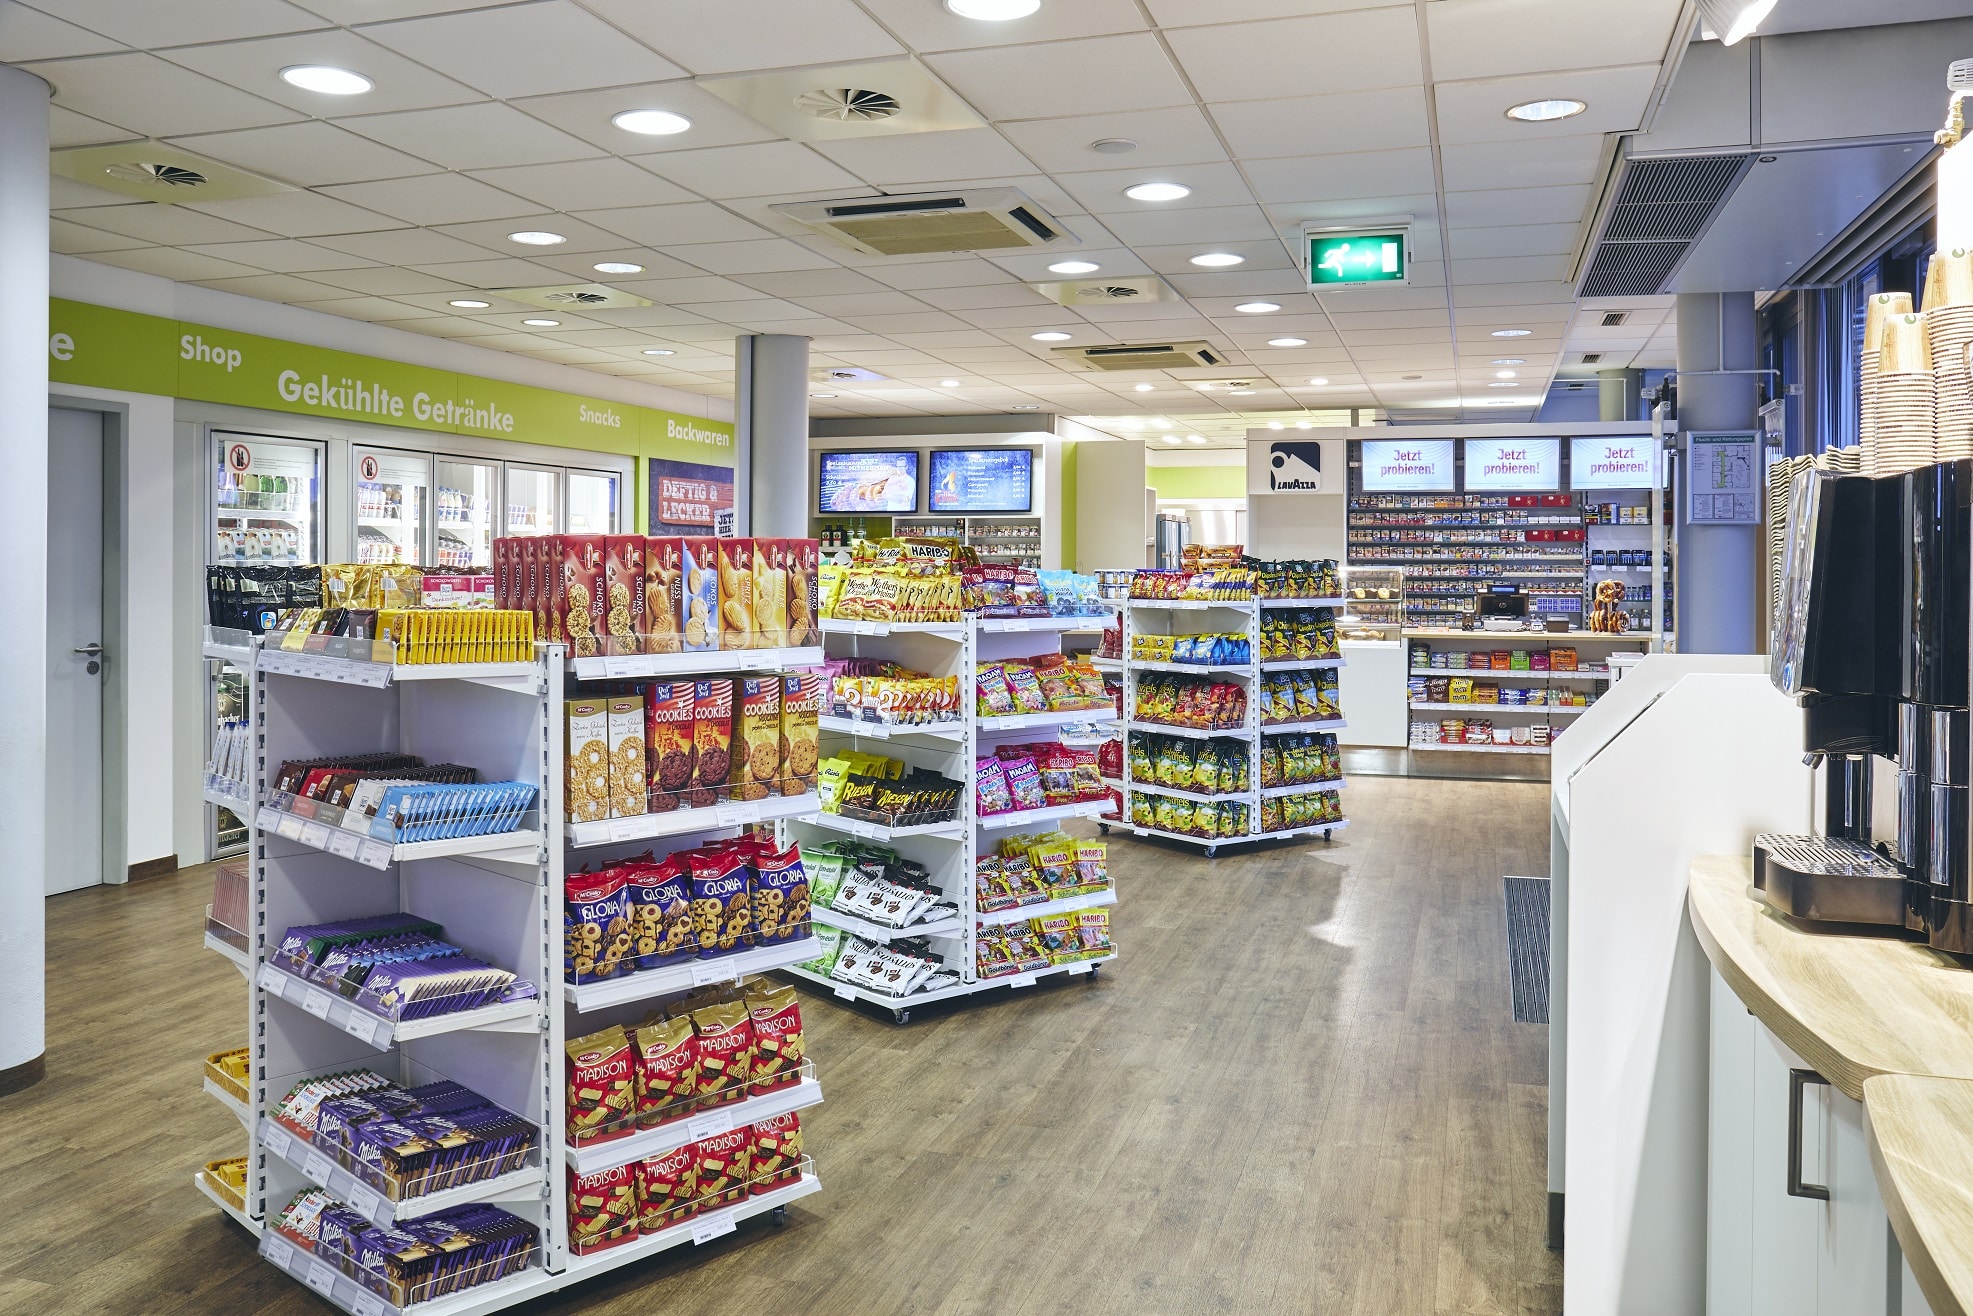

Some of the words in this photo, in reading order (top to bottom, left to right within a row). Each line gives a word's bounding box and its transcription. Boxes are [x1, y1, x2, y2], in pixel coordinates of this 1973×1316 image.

[180, 335, 242, 372] Shop
[278, 369, 404, 417] Gekühlte
[412, 392, 514, 432] Getränke
[579, 405, 621, 428] Snacks
[667, 419, 729, 447] Backwaren
[1393, 449, 1422, 461] Jetzt
[1497, 448, 1527, 460] Jetzt
[1605, 447, 1635, 459] Jetzt
[1380, 463, 1435, 477] probieren!
[1483, 462, 1540, 477] probieren!
[1590, 461, 1648, 475] probieren!
[662, 480, 707, 501] DEFTIG
[710, 484, 718, 501] &
[1277, 479, 1316, 490] LAVAZZA
[662, 501, 711, 522] LECKER
[911, 546, 950, 558] HARIBO
[656, 708, 693, 722] COOKIES
[695, 706, 732, 720] COOKIES
[744, 702, 779, 716] COOKIES
[786, 700, 818, 714] COOKIES
[1010, 762, 1036, 778] MAOAM
[842, 782, 876, 801] RIESEN
[877, 789, 910, 807] RIESEN
[1042, 854, 1068, 864] HARIBO
[1080, 849, 1104, 858] HARIBO
[1003, 862, 1030, 872] HARIBO
[768, 870, 804, 887] GLORIA
[643, 885, 682, 901] GLORIA
[704, 878, 742, 896] GLORIA
[582, 901, 620, 920] GLORIA
[1044, 919, 1070, 929] HARIBO
[1082, 915, 1106, 923] HARIBO
[1004, 928, 1031, 938] HARIBO
[282, 937, 302, 950] Milka
[321, 952, 348, 968] Milka
[368, 974, 392, 989] Milka
[756, 1015, 795, 1034] MADISON
[700, 1032, 745, 1052] MADISON
[648, 1049, 690, 1074] MADISON
[577, 1060, 627, 1084] MADISON
[320, 1111, 340, 1135] Milka
[753, 1113, 793, 1133] MADISON
[359, 1141, 381, 1161] Milka
[700, 1131, 744, 1155] MADISON
[648, 1152, 690, 1179] MADISON
[577, 1166, 627, 1191] MADISON
[322, 1220, 342, 1244] Milka
[361, 1248, 385, 1268] Milka
